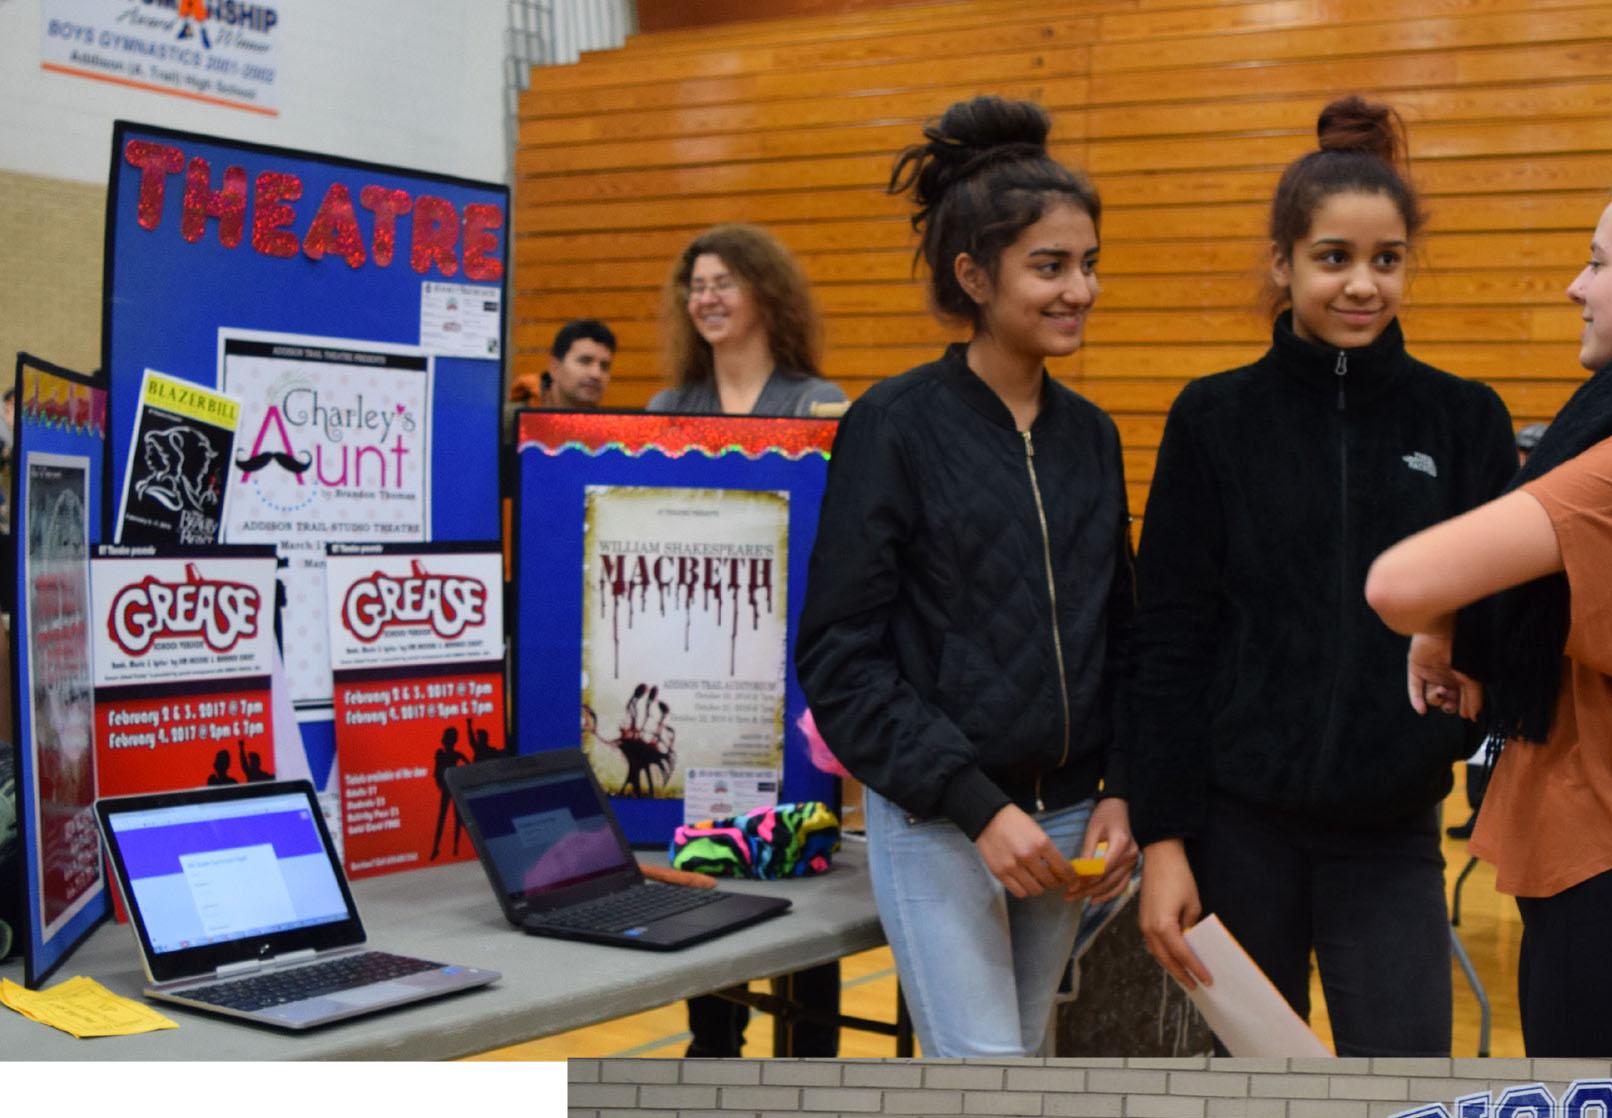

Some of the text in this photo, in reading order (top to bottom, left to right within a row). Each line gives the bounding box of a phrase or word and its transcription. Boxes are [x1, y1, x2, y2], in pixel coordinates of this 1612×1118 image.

[48, 19, 94, 43] BOYS
[100, 30, 200, 67] GYMNASTICS
[124, 139, 504, 281] THEATRE
[147, 380, 238, 422] BLAZERBILL
[282, 388, 416, 442] Charley's
[239, 405, 409, 488] Aunt
[242, 521, 292, 531] ADDISON
[296, 522, 326, 531] TRAIL
[600, 541, 774, 556] WILLIAM SHAKESPEARE'S
[600, 554, 774, 604] MACBETH
[110, 578, 260, 654] GREASE
[344, 574, 485, 641] GREASE
[108, 708, 159, 727] February
[199, 701, 226, 718] 2017
[240, 699, 264, 717] 7pm
[344, 691, 391, 706] February
[427, 683, 454, 699] 2017
[469, 681, 492, 697] 7pm
[346, 710, 388, 725] February
[401, 704, 425, 720] 2017
[472, 701, 493, 716] 7pm
[108, 731, 156, 750] February
[170, 726, 197, 743] 2017
[242, 721, 264, 738] 7pm
